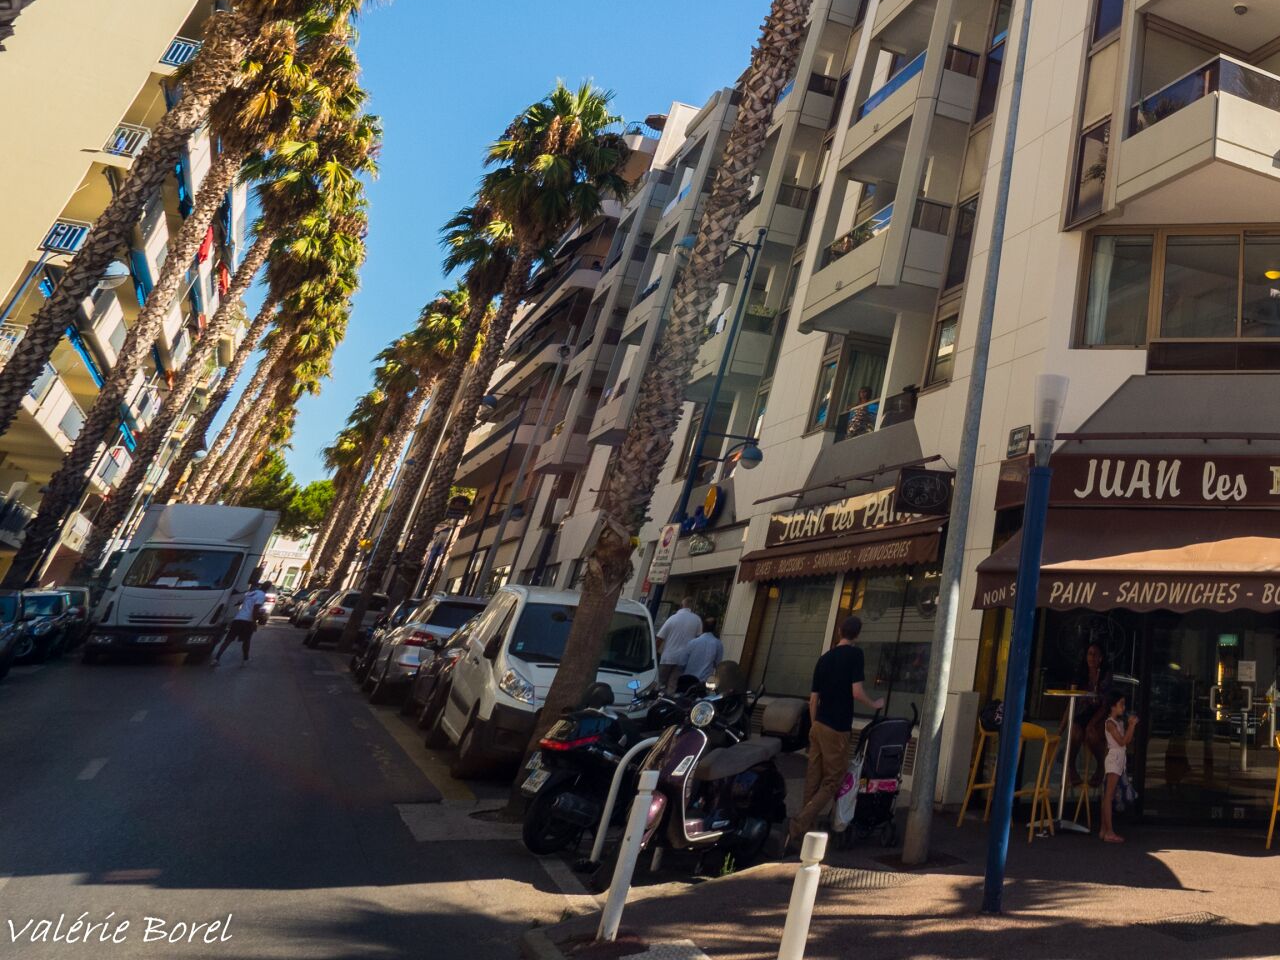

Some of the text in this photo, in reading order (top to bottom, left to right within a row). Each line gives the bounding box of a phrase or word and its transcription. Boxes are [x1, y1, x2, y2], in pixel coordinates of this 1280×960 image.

[1074, 459, 1181, 500] JUAN
[1202, 461, 1247, 501] les
[780, 505, 826, 541] JUAN
[812, 550, 852, 569] SANDWICHES
[983, 587, 1006, 606] NON
[1049, 581, 1097, 604] PAIN
[1116, 581, 1240, 605] SANDWICHES
